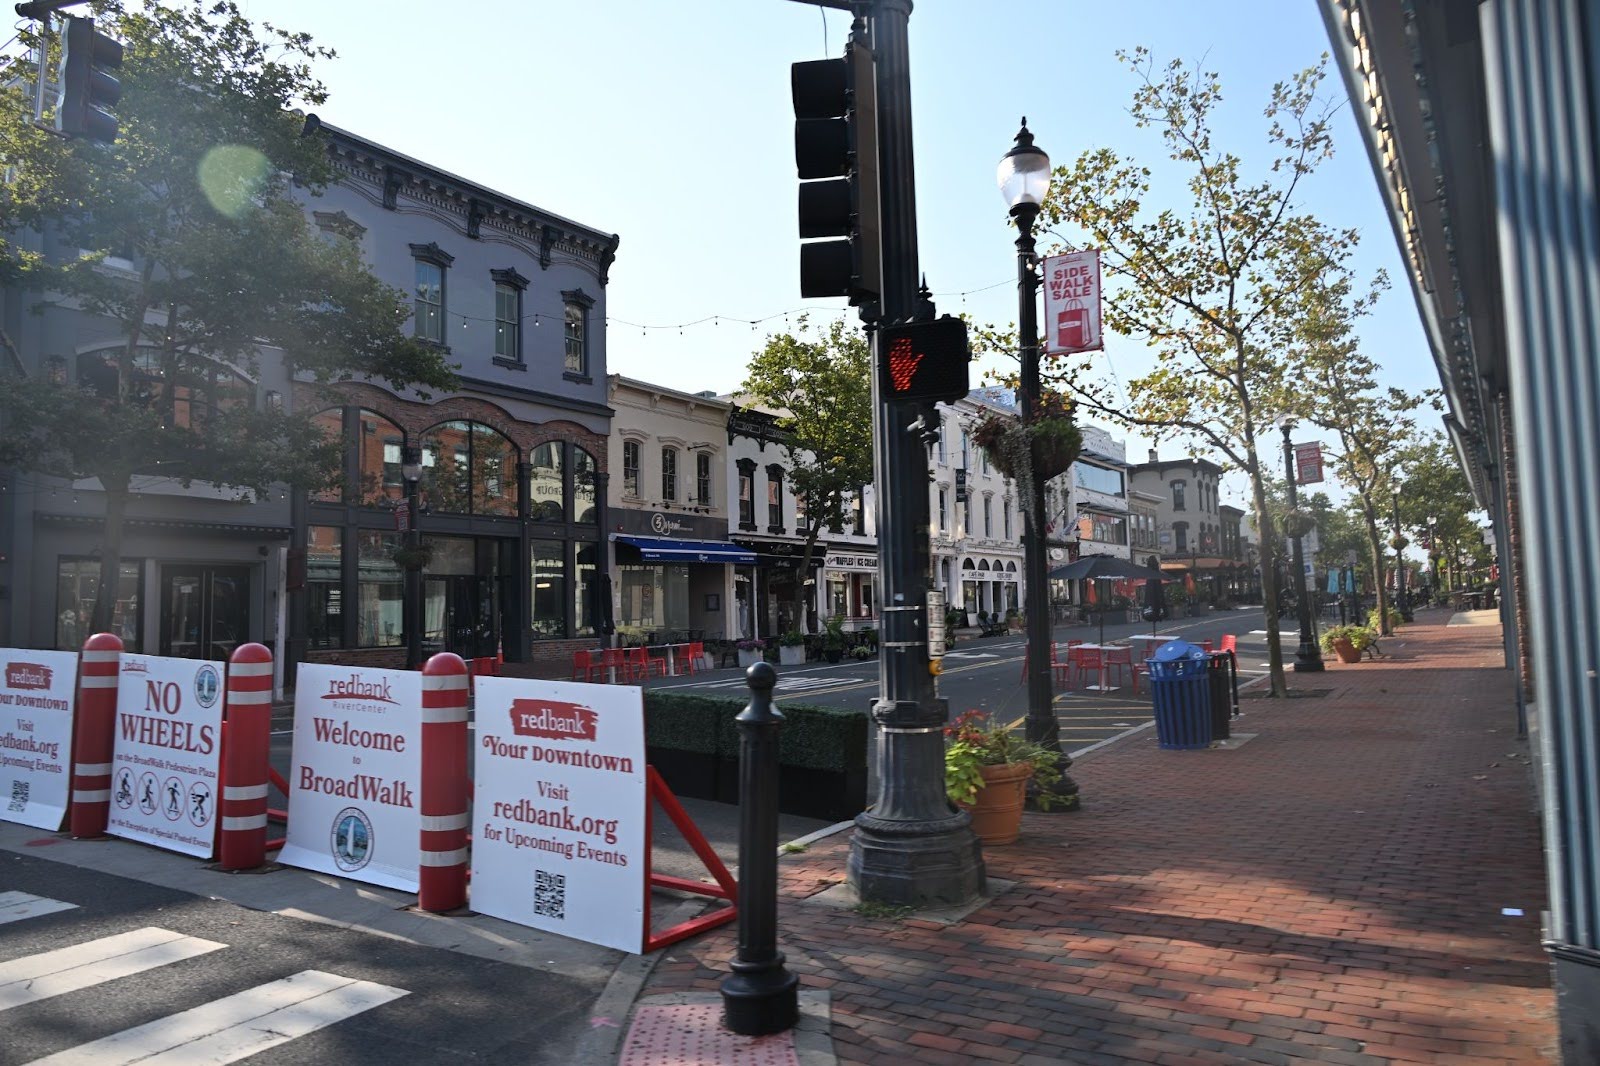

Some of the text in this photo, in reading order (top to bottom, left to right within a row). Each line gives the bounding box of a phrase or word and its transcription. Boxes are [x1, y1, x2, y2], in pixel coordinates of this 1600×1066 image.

[1050, 275, 1094, 290] WALK
[1054, 265, 1089, 280] SIDE
[1053, 286, 1091, 300] SALE
[11, 667, 46, 686] redbank
[329, 674, 392, 699] redbank
[16, 694, 69, 711] Downtown
[145, 680, 182, 715] NO
[332, 701, 387, 714] RiverCenter
[17, 719, 34, 732] Visit
[520, 708, 586, 735] redbank
[120, 713, 214, 755] WHEELS
[313, 717, 405, 753] Welcome
[0, 733, 59, 760] edbank.org
[483, 735, 634, 774] Your Downtown
[36, 758, 63, 774] Events
[124, 754, 134, 762] the
[134, 755, 165, 769] BroadWalk
[165, 761, 198, 775] Pedestrian
[198, 766, 216, 778] Plaza
[352, 756, 361, 765] to
[299, 766, 413, 808] BroadWalk
[537, 780, 569, 801] Visit
[494, 799, 619, 845] redbank.org
[192, 836, 211, 849] Events
[484, 824, 628, 867] for Upcoming Events
